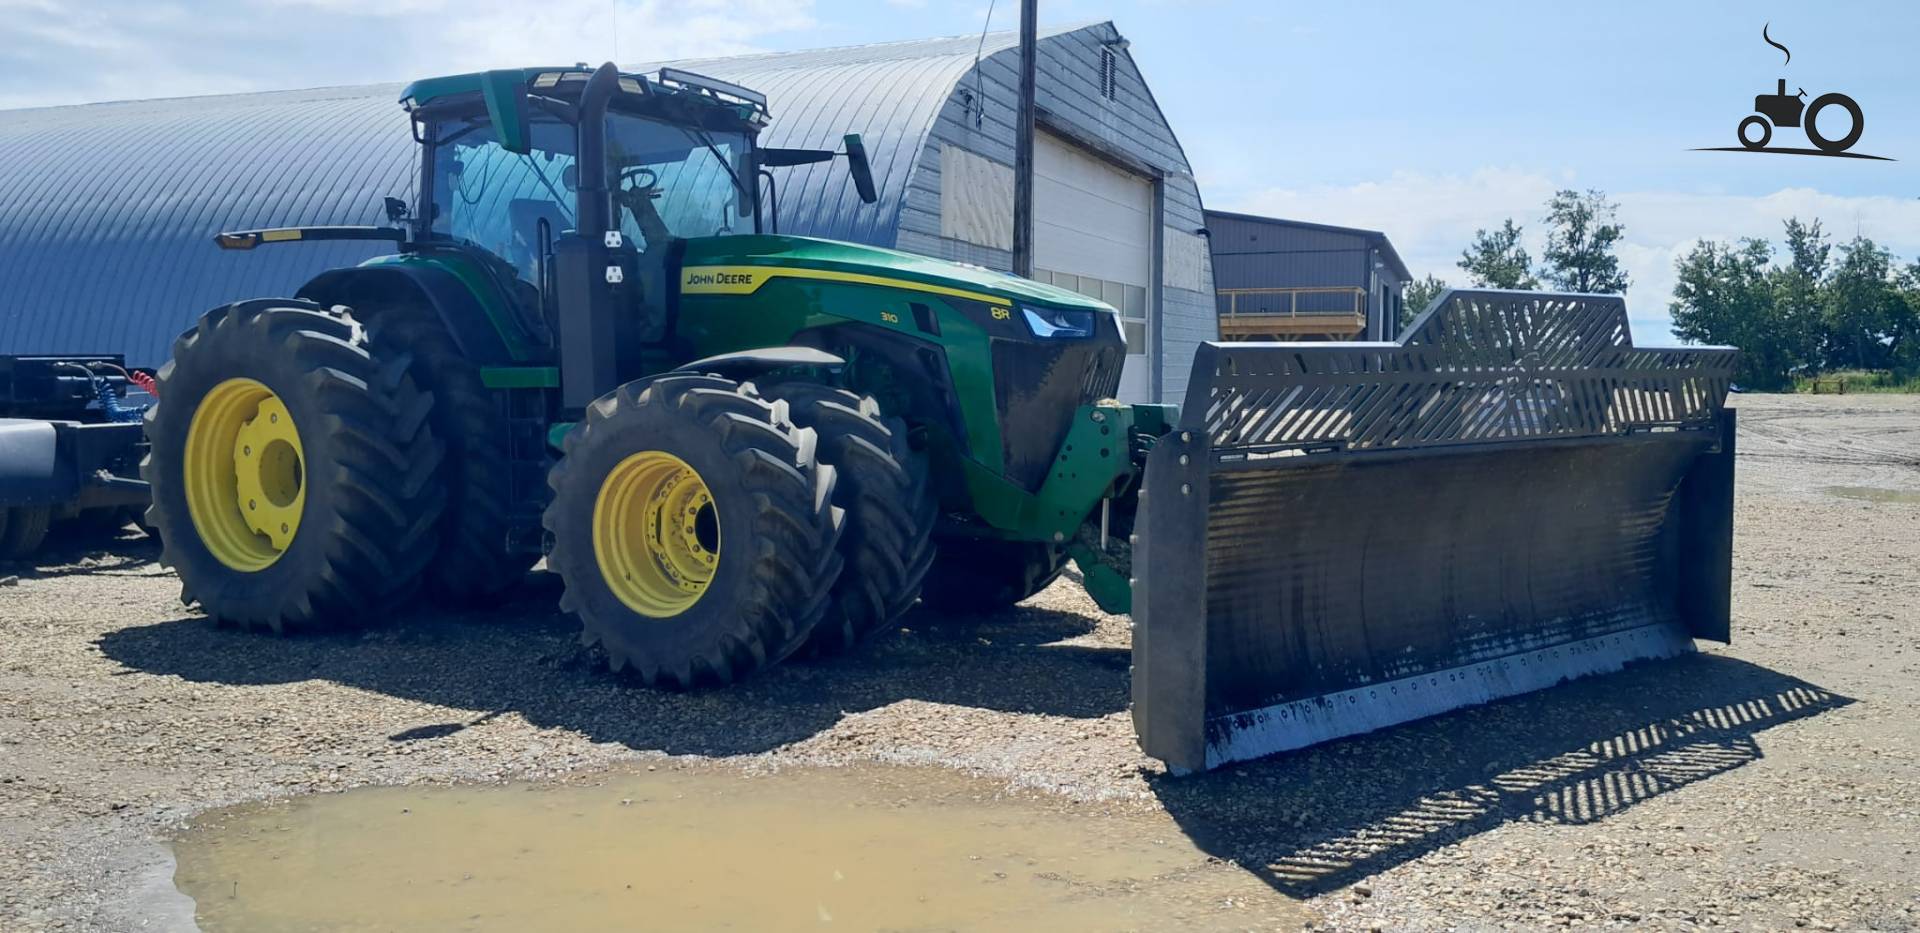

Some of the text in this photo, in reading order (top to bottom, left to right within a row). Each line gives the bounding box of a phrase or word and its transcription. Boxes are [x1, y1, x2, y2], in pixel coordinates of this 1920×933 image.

[687, 273, 752, 285] JOHN DEERE
[880, 311, 898, 323] 310
[990, 307, 1010, 320] 8R
